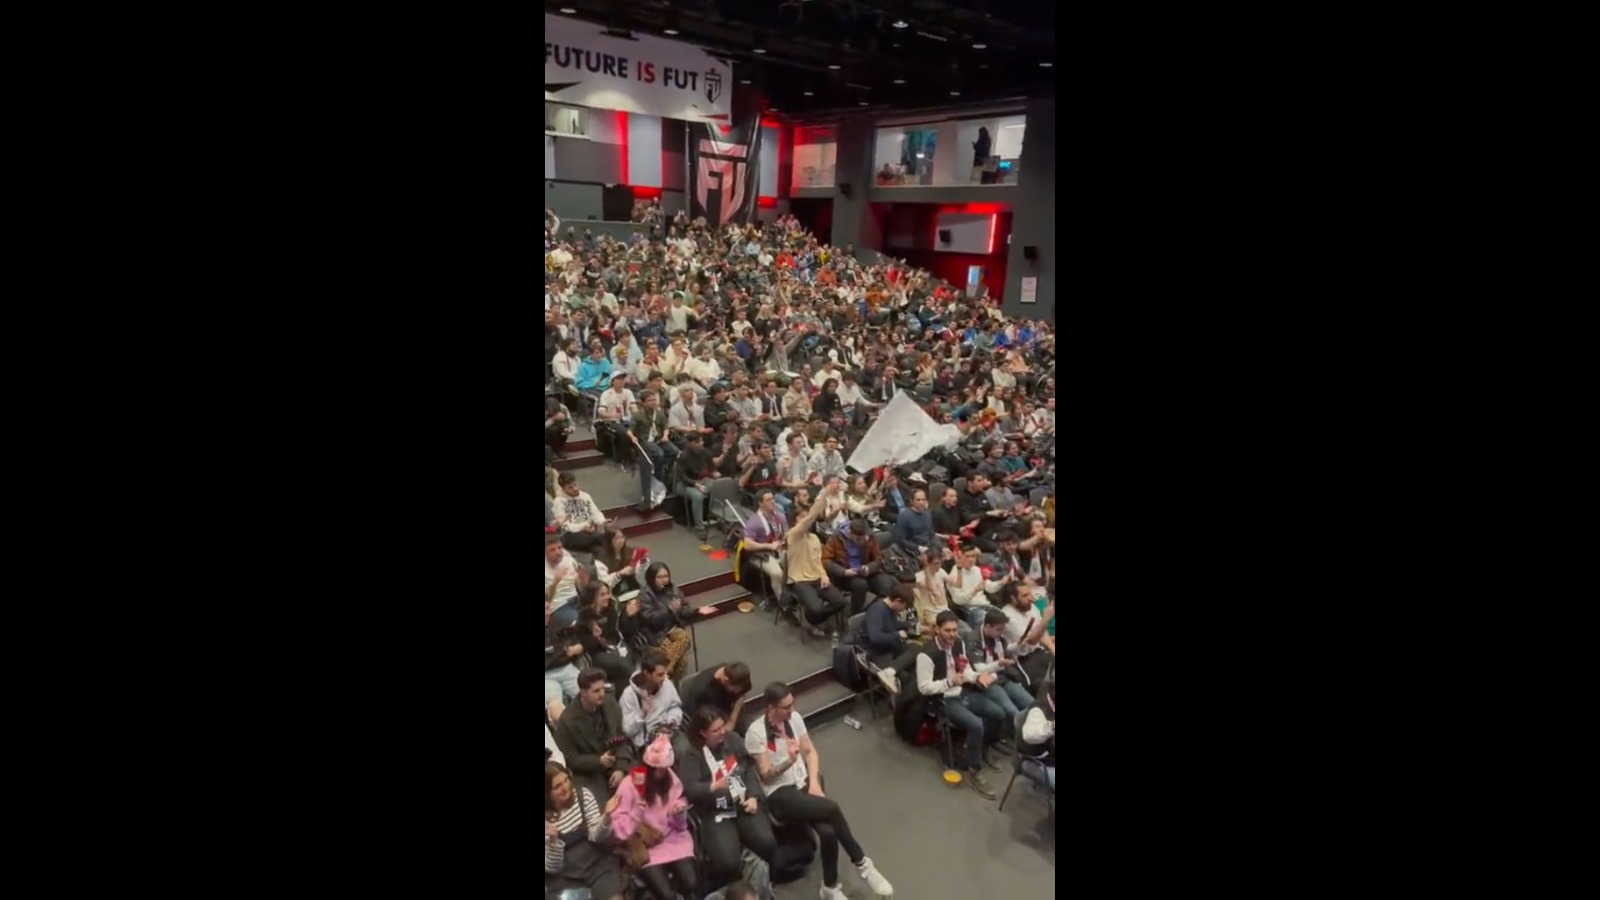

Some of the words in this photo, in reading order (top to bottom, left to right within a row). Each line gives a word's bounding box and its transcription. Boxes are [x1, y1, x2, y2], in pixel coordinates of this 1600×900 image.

[545, 43, 628, 78] FUTURE
[637, 61, 656, 83] IS
[663, 67, 699, 91] FUT
